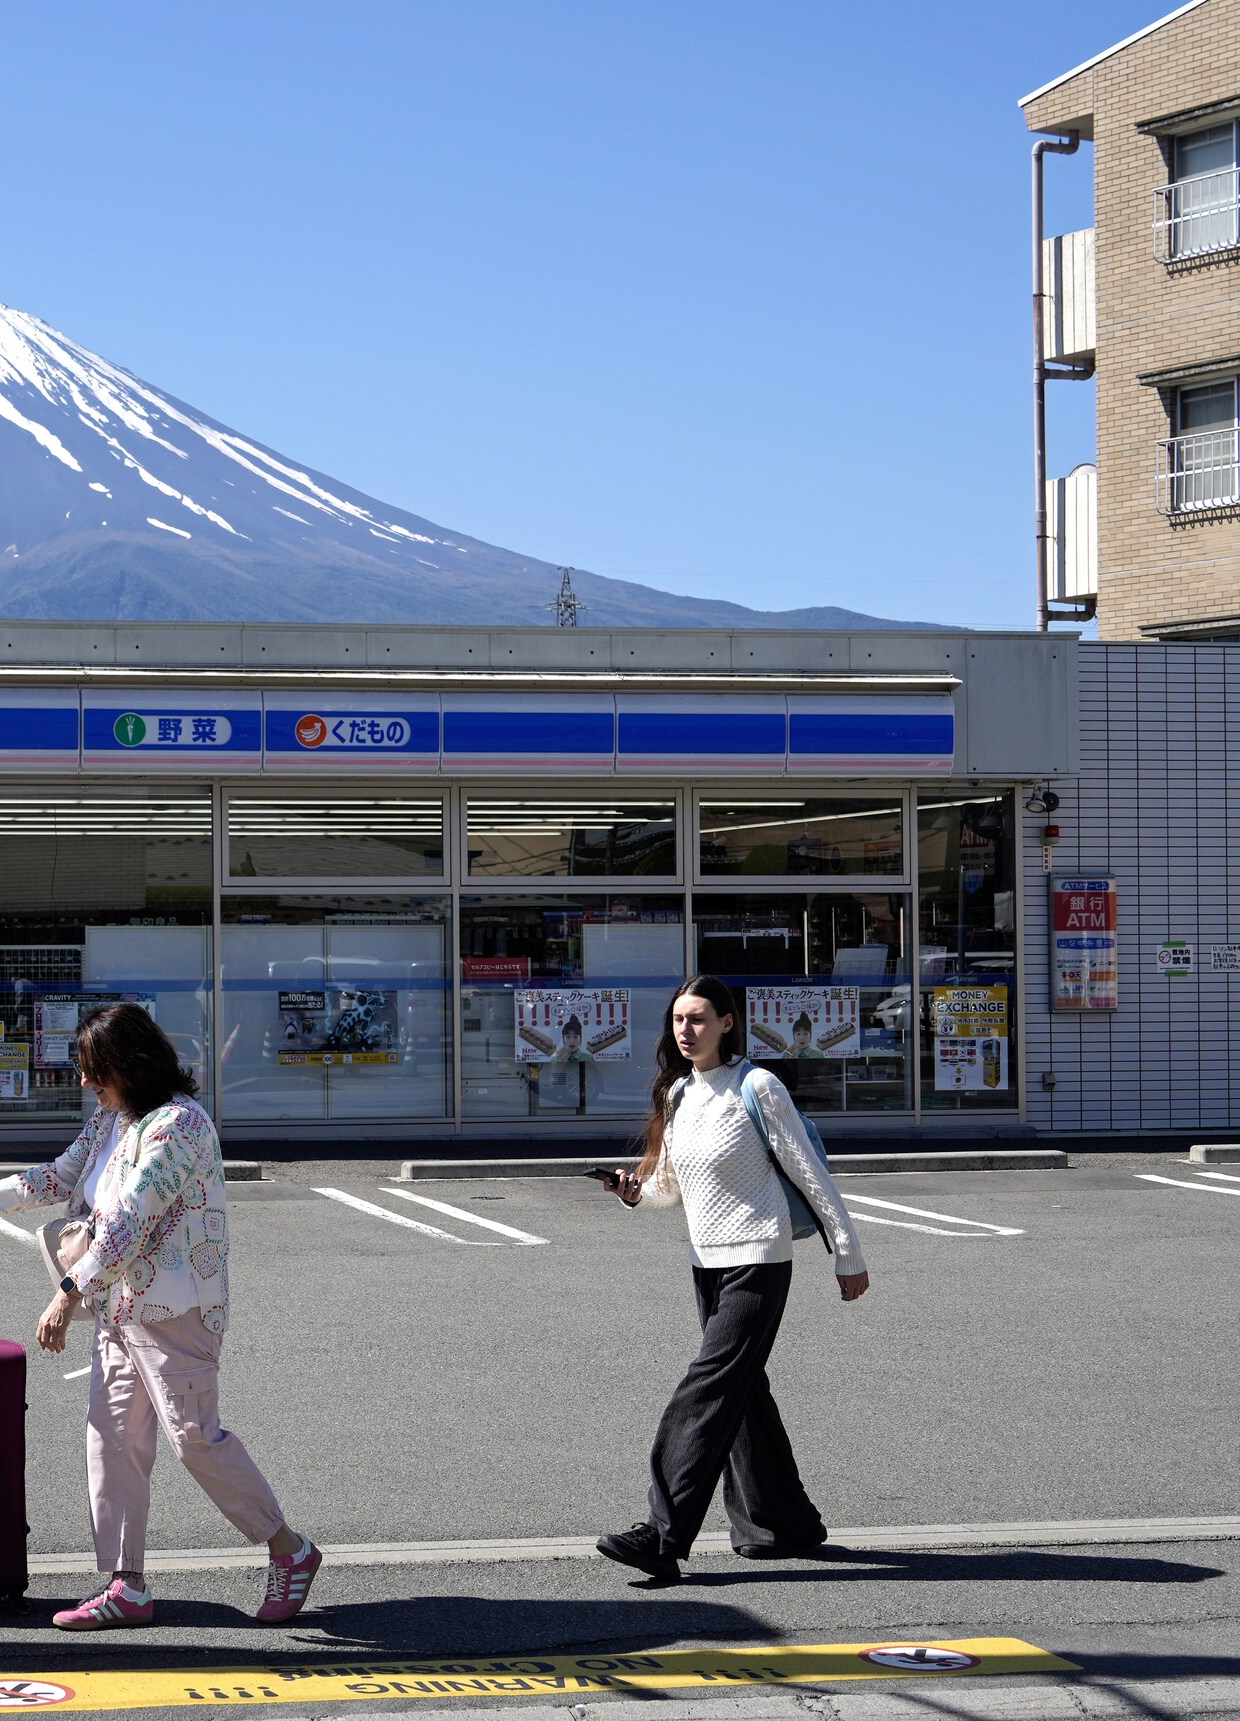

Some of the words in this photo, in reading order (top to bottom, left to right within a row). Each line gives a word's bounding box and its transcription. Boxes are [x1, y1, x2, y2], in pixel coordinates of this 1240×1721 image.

[158, 718, 217, 743] 野菜
[331, 720, 404, 744] くだもの
[1064, 882, 1109, 890] ATMサービス
[1070, 896, 1104, 910] 銀行
[1066, 913, 1105, 927] ATM
[952, 990, 989, 999] MONEY
[937, 1002, 1005, 1013] EXCHANGE
[269, 1660, 556, 1681] Crossing
[575, 1656, 665, 1671] NO
[344, 1674, 634, 1694] WARNING
